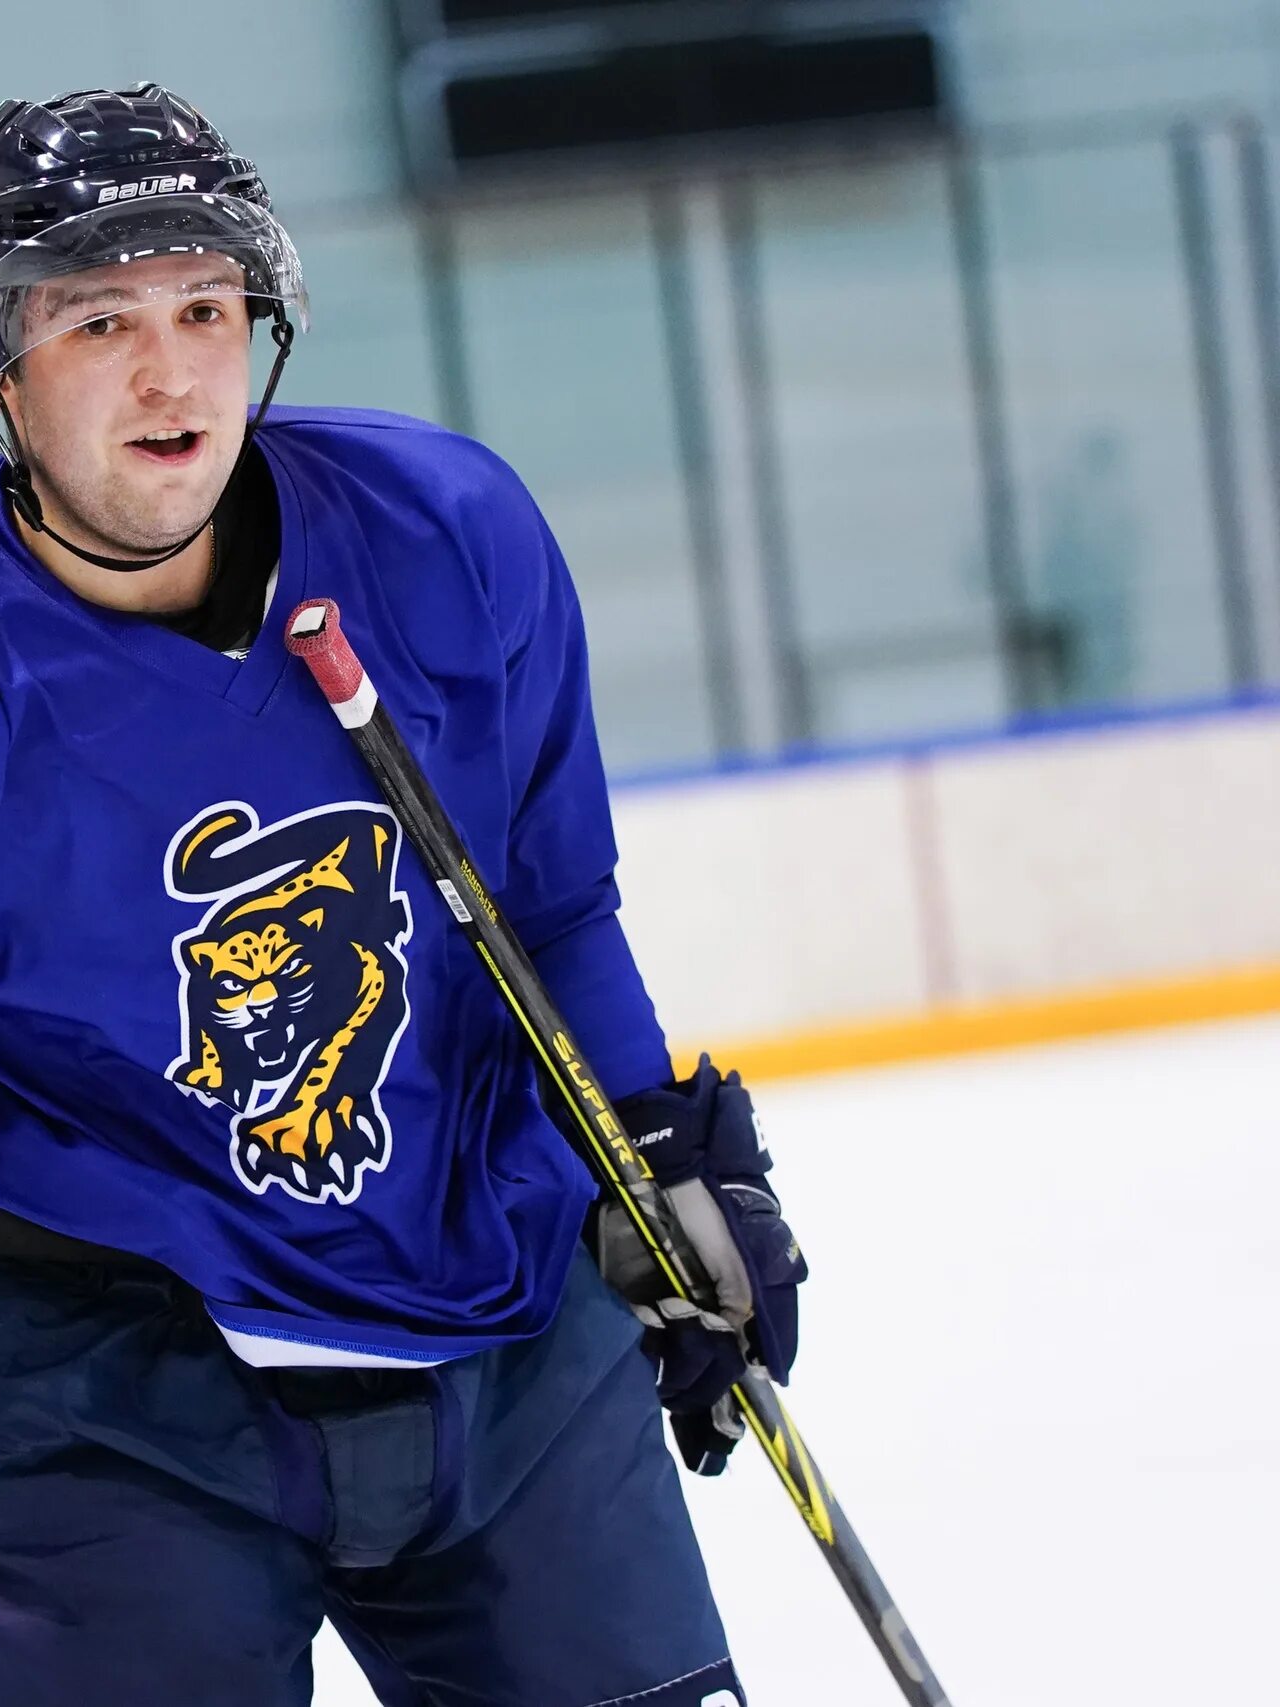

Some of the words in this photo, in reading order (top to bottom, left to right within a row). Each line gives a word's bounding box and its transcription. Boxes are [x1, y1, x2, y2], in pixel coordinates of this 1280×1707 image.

[98, 173, 197, 203] BAUER
[553, 1031, 635, 1165] SUPER
[632, 1127, 673, 1147] UER
